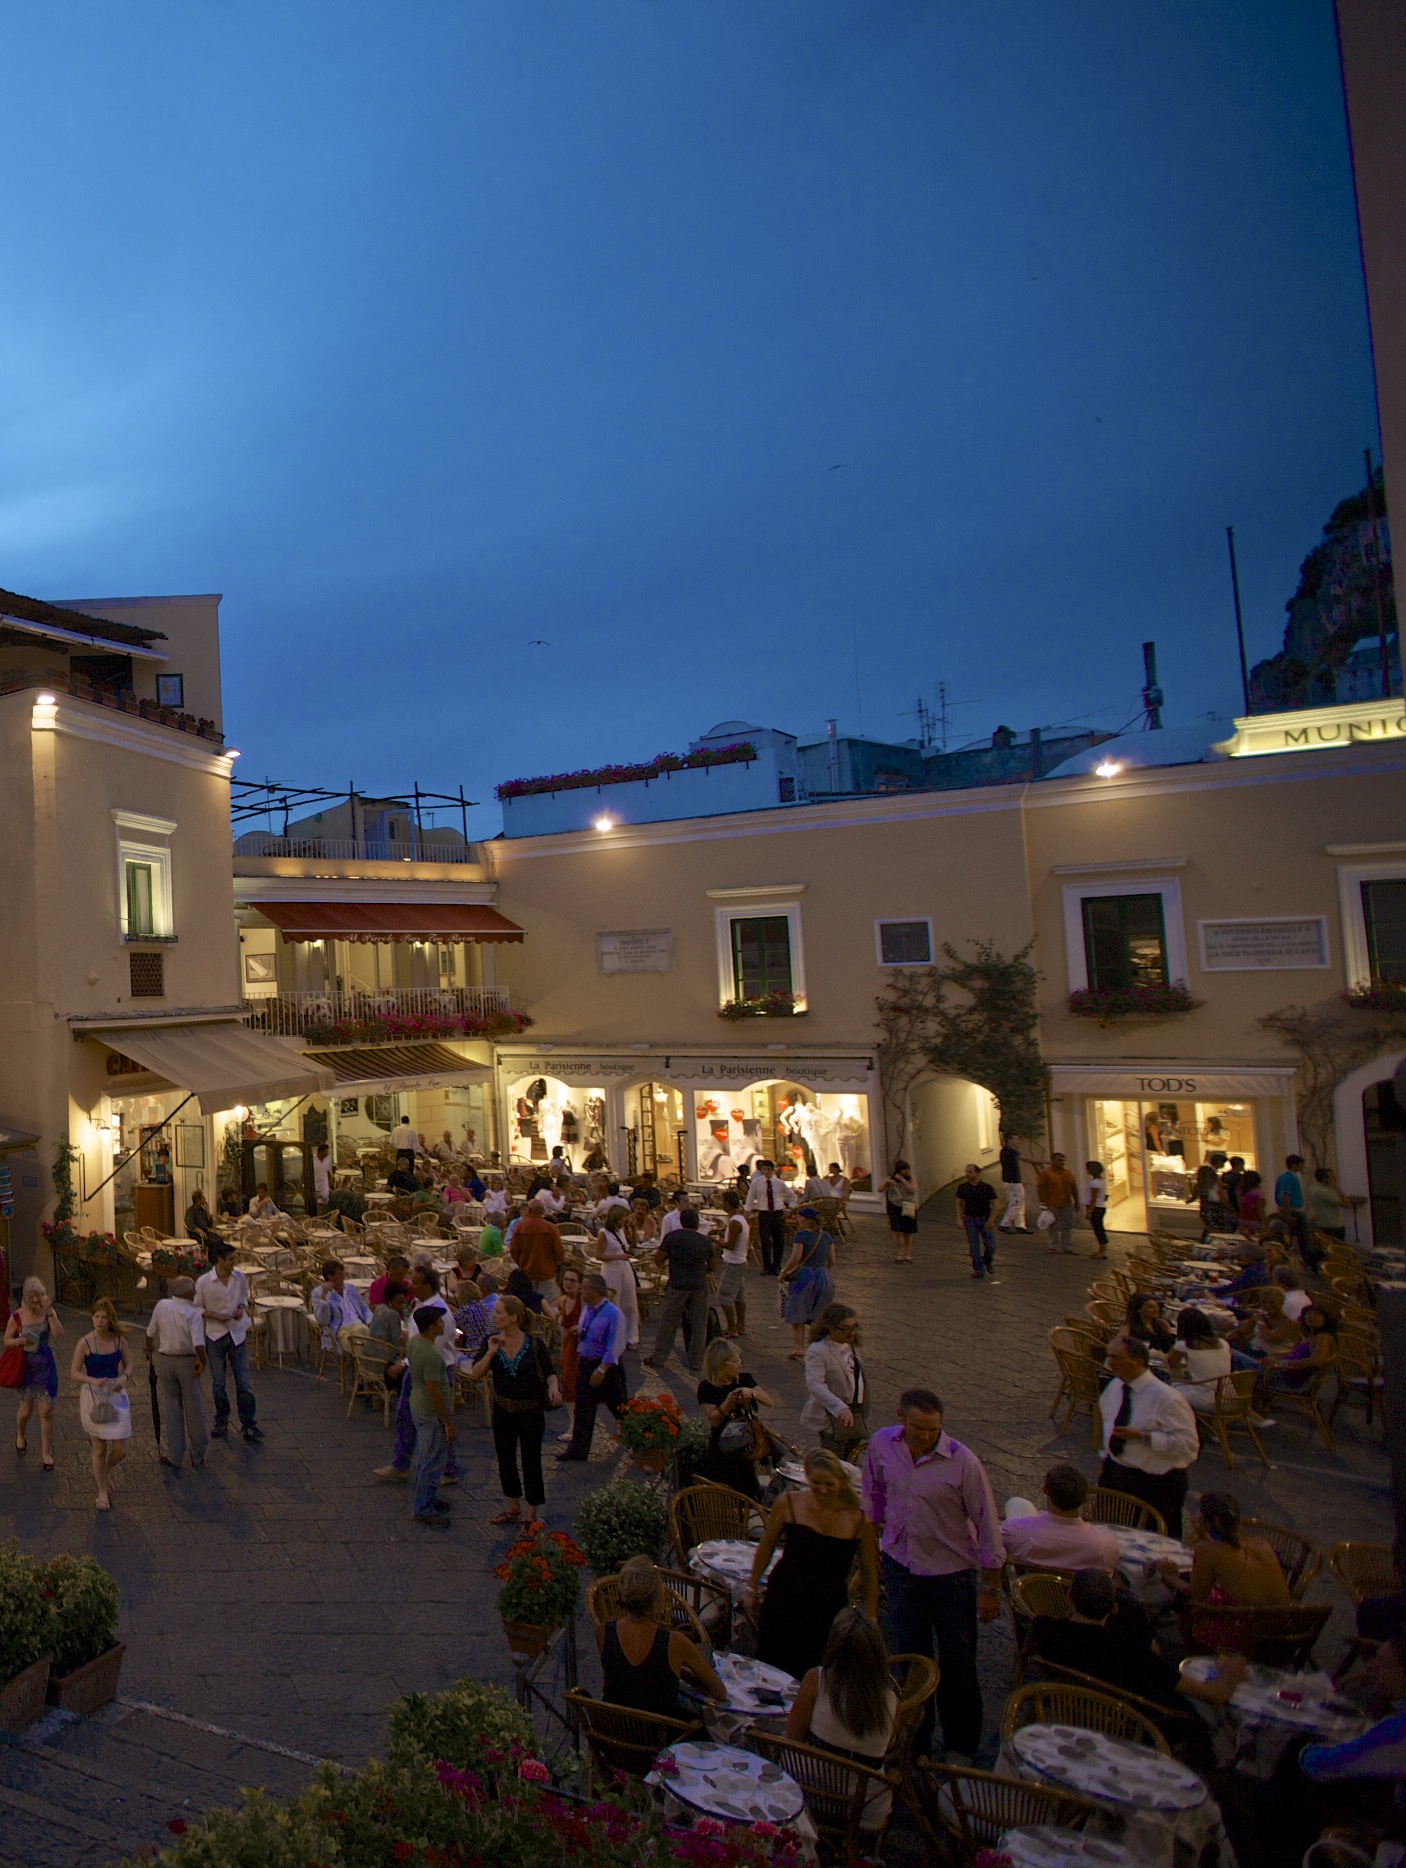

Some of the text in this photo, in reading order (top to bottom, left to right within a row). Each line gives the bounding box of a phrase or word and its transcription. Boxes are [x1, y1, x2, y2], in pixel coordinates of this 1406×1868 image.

[448, 933, 475, 942] Room
[529, 1061, 635, 1072] La Parisienne boutique
[702, 1064, 828, 1077] La Parisienne boutique
[1135, 1077, 1196, 1093] TOD'S
